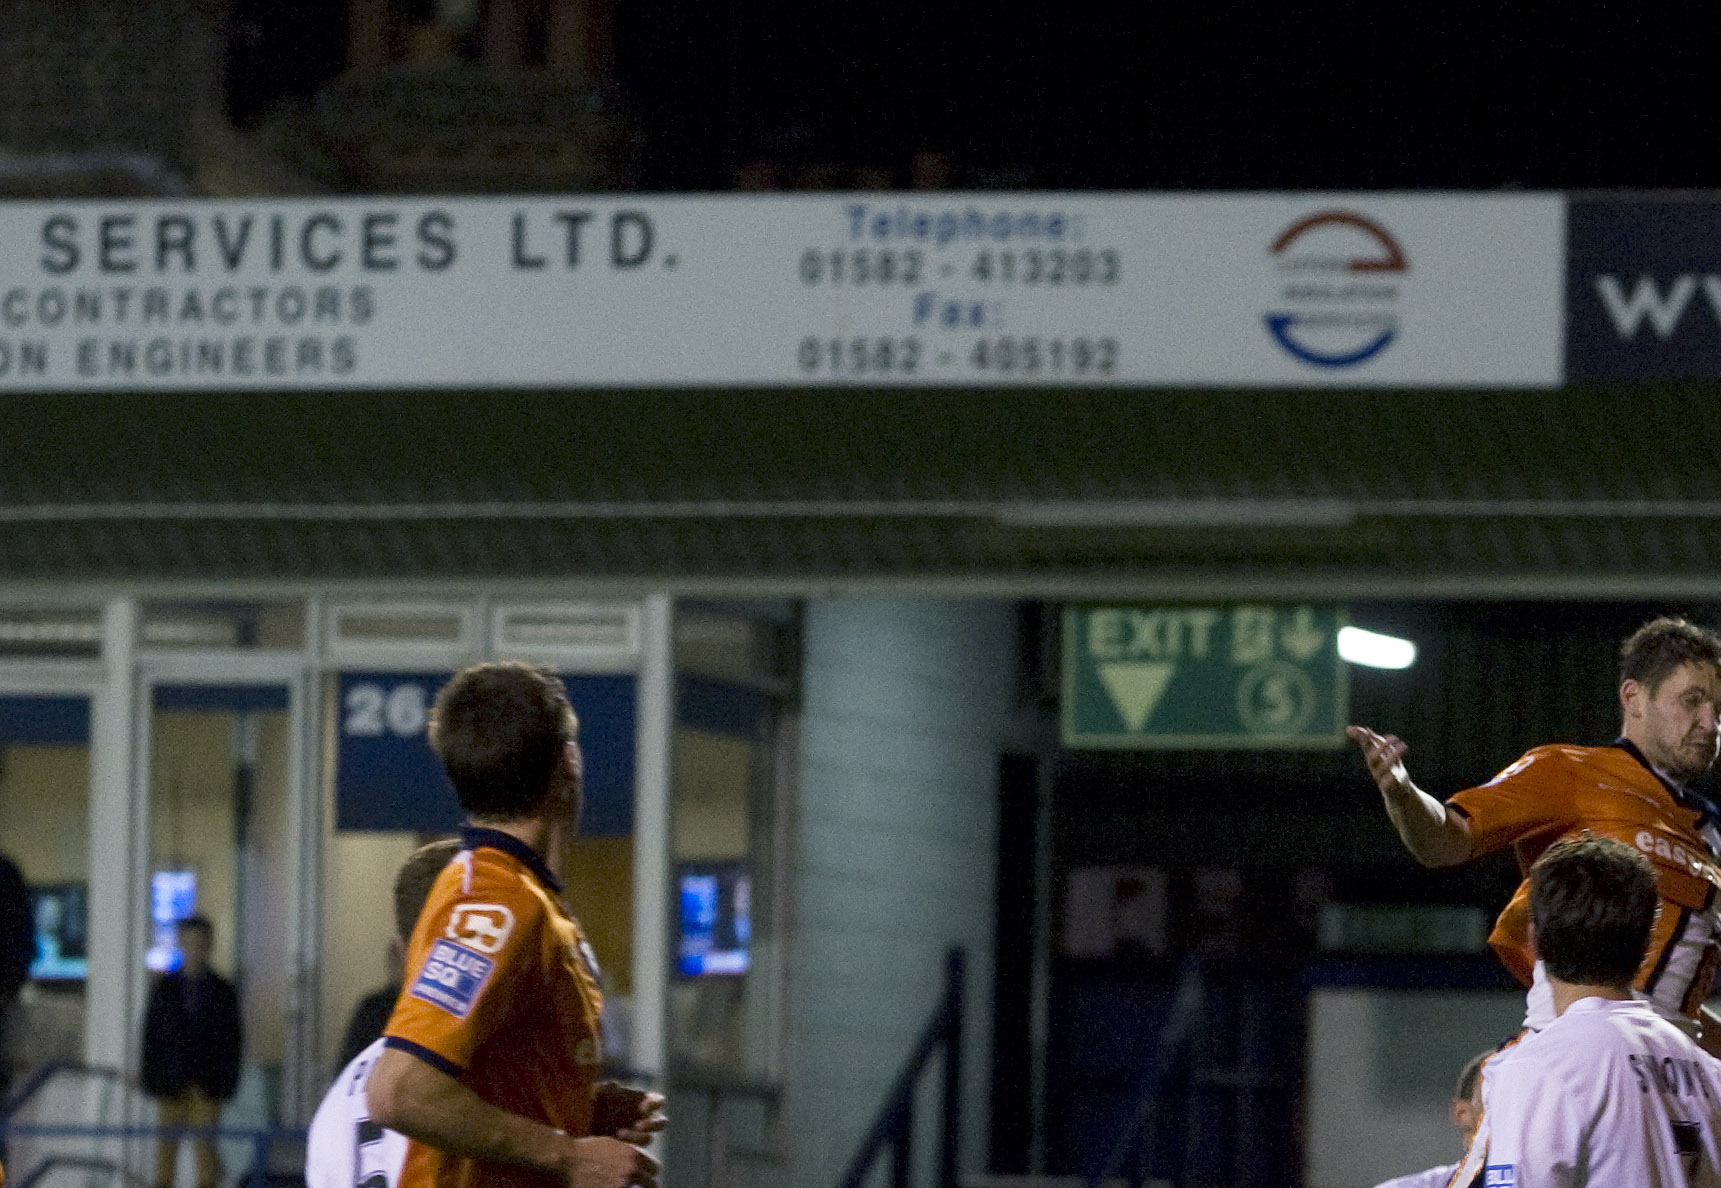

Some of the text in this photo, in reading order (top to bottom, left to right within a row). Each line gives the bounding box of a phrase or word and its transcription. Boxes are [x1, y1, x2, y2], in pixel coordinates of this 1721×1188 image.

[40, 208, 682, 275] SERVICES LTD.
[800, 248, 924, 286] 01582
[2, 285, 375, 328] CONTRACTORS
[75, 336, 357, 376] ENGINEERS
[800, 335, 921, 374] 01582
[1088, 607, 1216, 657] EXIT
[345, 684, 427, 737] 26
[432, 944, 489, 979] BLUE
